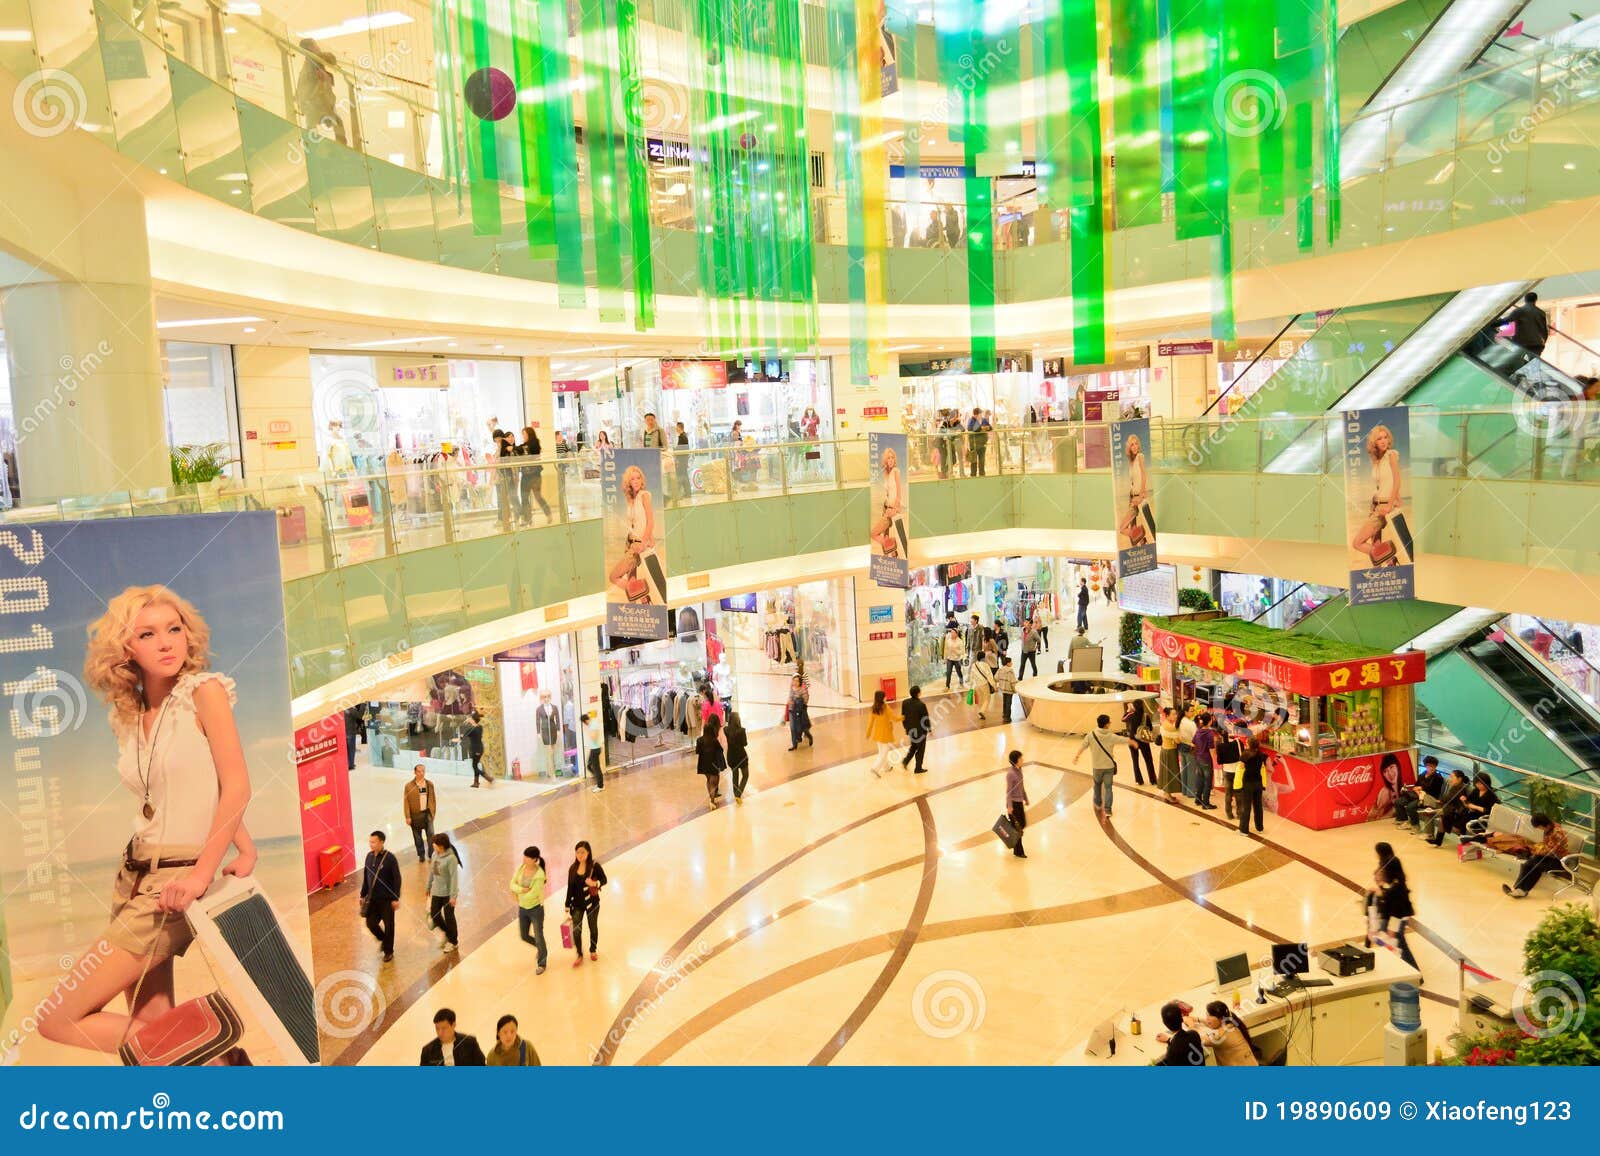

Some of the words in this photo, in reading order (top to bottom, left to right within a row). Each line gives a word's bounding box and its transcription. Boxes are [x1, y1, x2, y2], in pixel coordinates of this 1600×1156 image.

[1159, 346, 1173, 355] 2F
[1106, 391, 1119, 400] 2F
[1329, 660, 1406, 688] 口渴了
